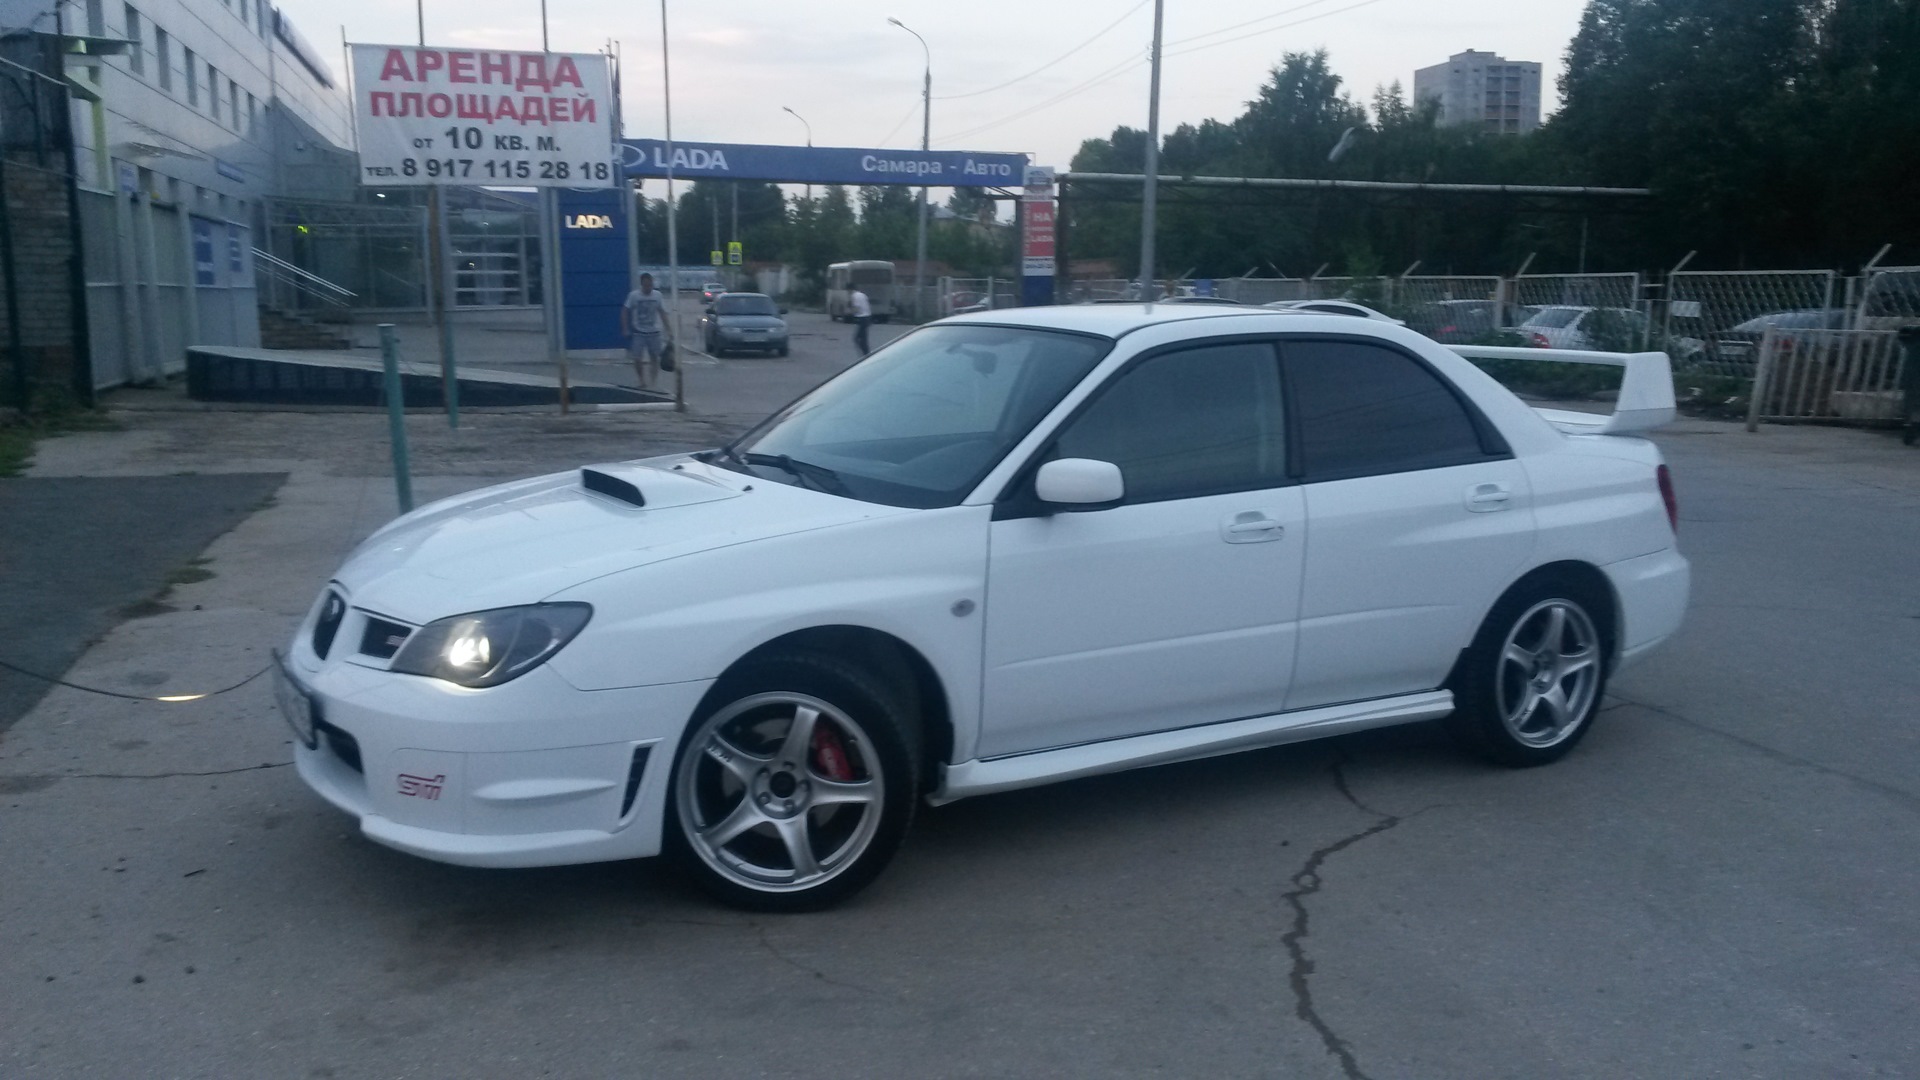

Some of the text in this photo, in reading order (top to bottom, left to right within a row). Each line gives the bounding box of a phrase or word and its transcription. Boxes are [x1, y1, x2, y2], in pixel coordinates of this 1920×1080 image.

[380, 49, 584, 92] АРЕНДА
[370, 91, 596, 125] ПЛОЩАДЕЙ
[445, 127, 482, 149] 10
[403, 158, 417, 177] 8
[427, 158, 473, 177] 917
[485, 160, 530, 178] 115
[540, 161, 570, 179] 28
[580, 163, 609, 180] 18
[653, 147, 729, 171] LADA
[861, 154, 942, 176] Самара
[963, 158, 1011, 176] Авто
[564, 214, 613, 229] LADA
